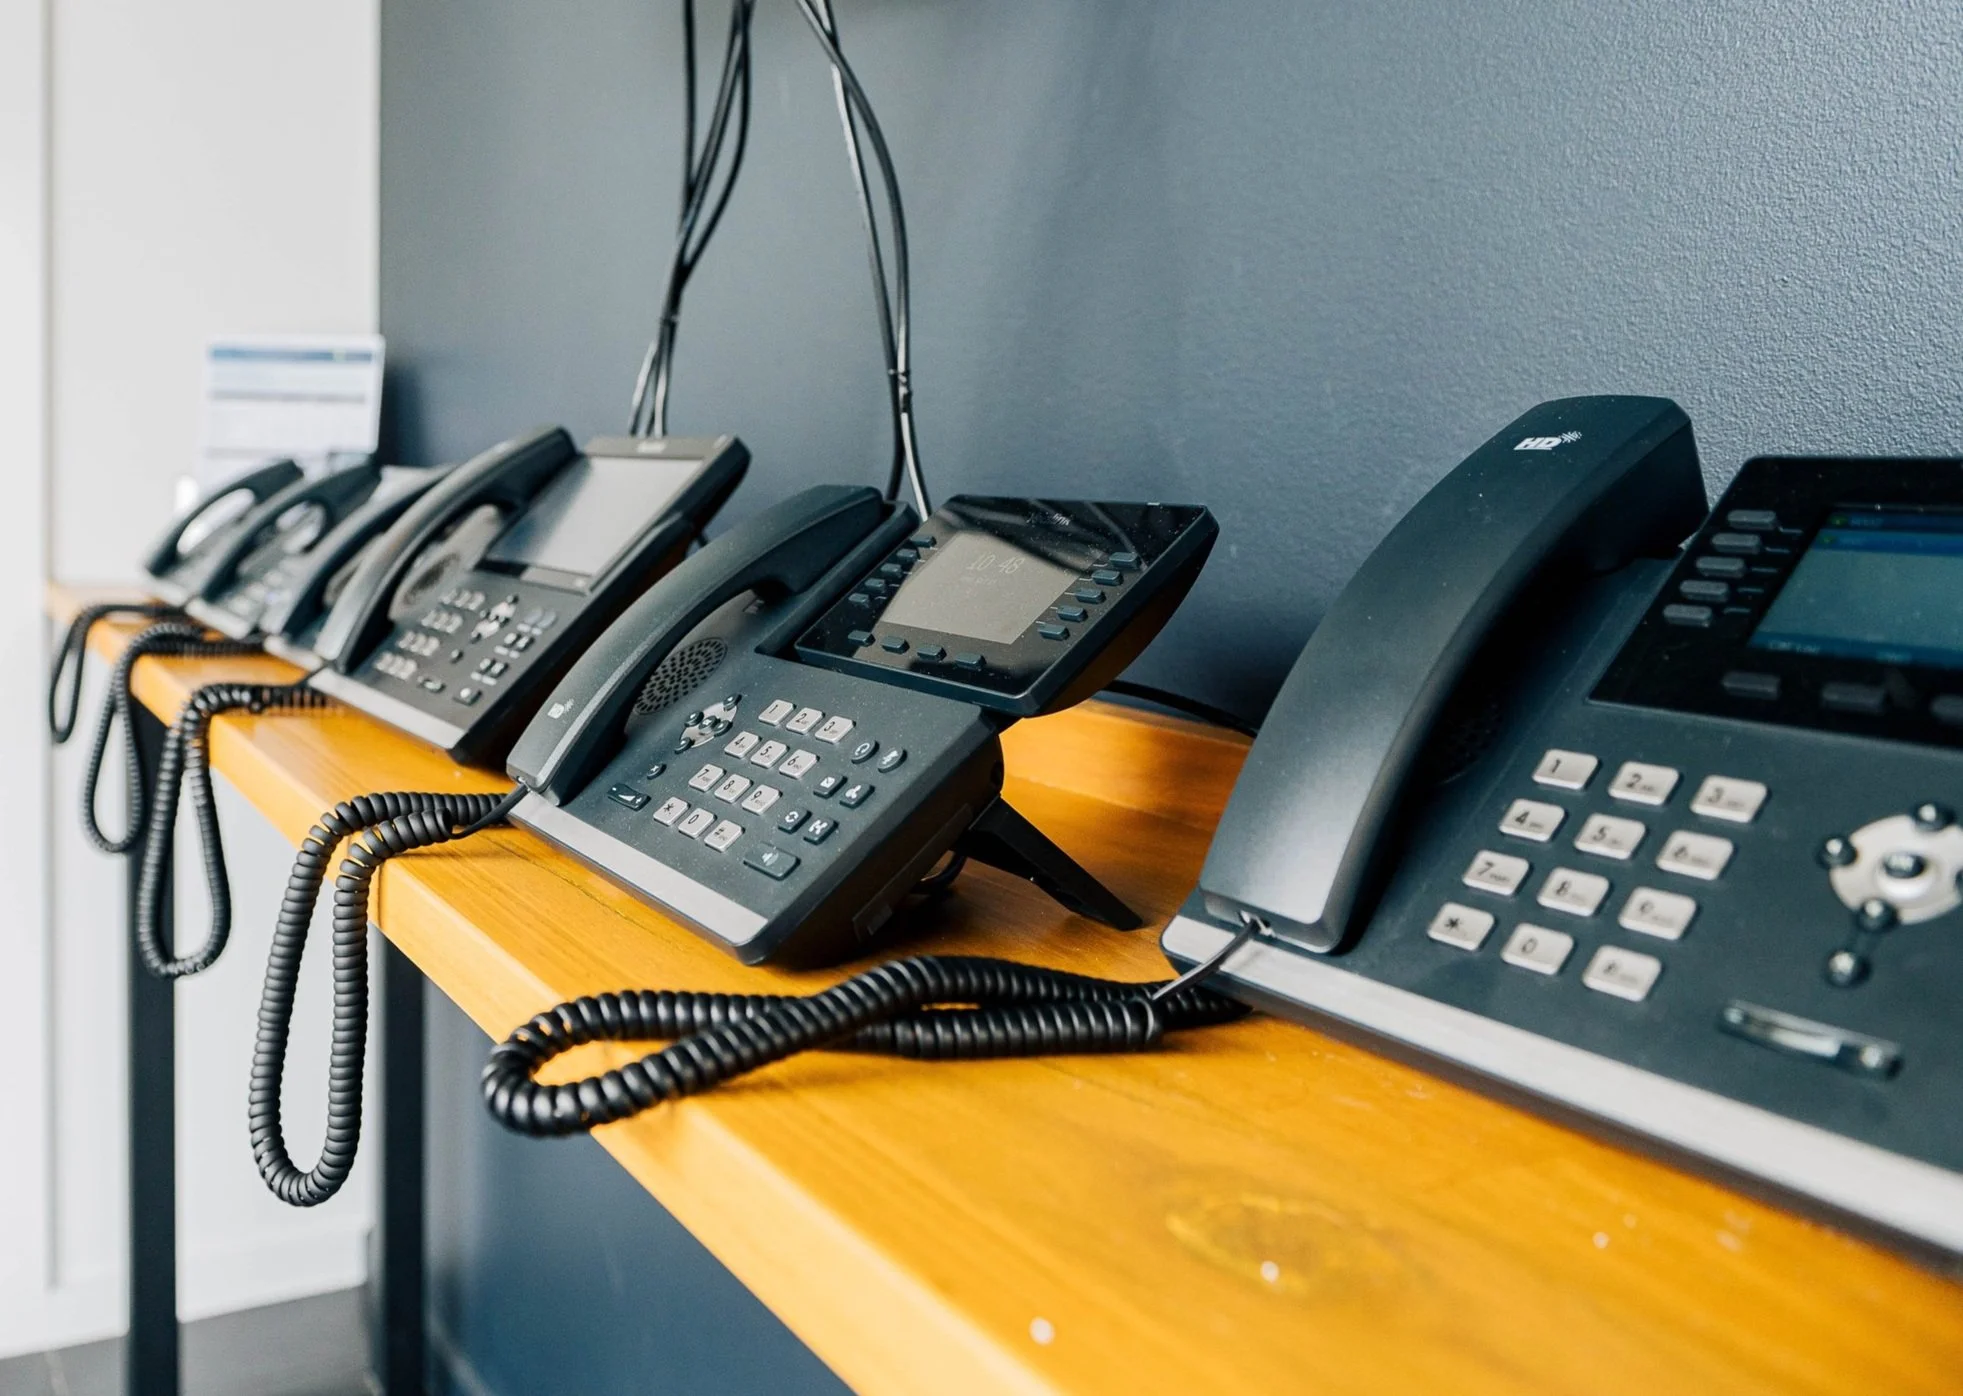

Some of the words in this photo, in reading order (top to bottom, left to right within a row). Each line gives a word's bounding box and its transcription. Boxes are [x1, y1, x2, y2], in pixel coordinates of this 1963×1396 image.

[1513, 437, 1562, 450] HD
[769, 704, 779, 714] 1
[795, 713, 807, 723] 2
[824, 722, 835, 732] 3
[734, 737, 745, 746] 4
[760, 745, 773, 756] 5
[788, 756, 799, 766] 6
[1549, 759, 1561, 774] 1
[698, 769, 709, 778] 7
[724, 780, 735, 790] 8
[1626, 773, 1642, 789] 2
[751, 791, 762, 801] 9
[1707, 786, 1725, 803] 3
[688, 814, 699, 824] 0
[1514, 811, 1530, 825] 4
[1592, 825, 1610, 841] 5
[1477, 860, 1495, 876] 7
[1521, 937, 1539, 954] 0
